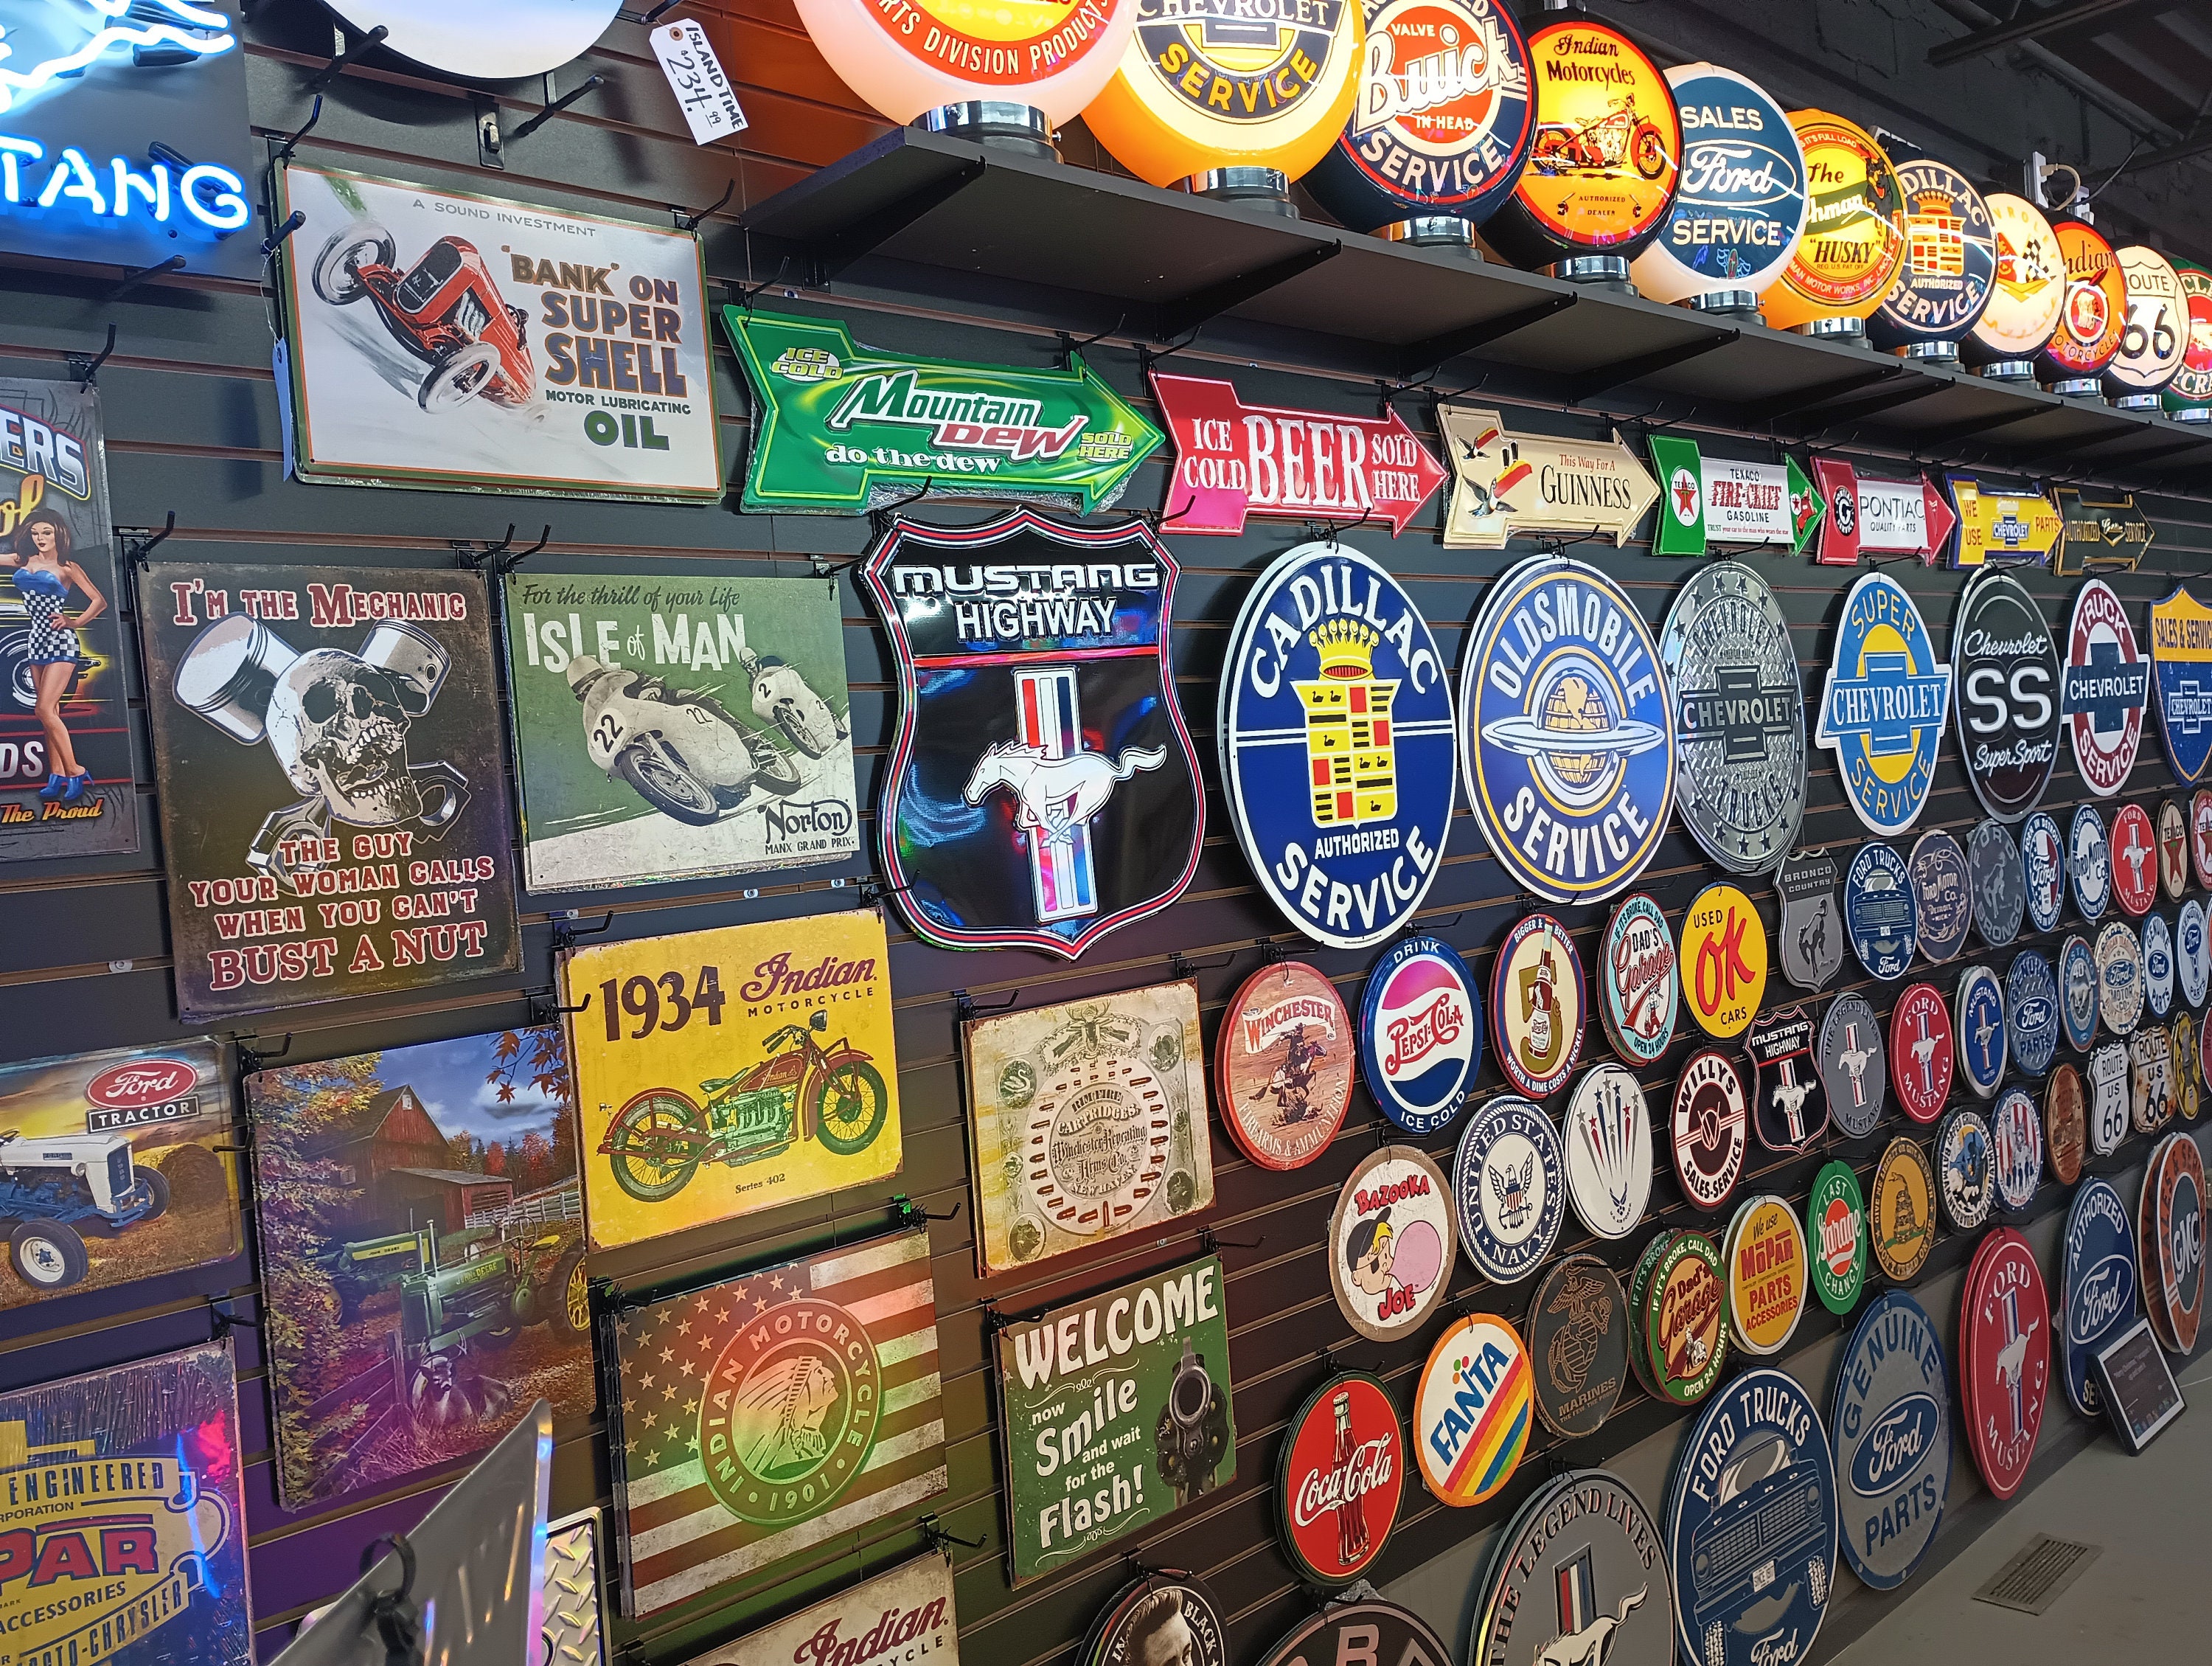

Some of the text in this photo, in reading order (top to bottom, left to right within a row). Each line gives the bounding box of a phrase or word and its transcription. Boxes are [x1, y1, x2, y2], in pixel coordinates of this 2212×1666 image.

[1391, 24, 1435, 37] VALVE
[1554, 34, 1619, 57] Indian
[685, 27, 743, 129] ISLAND TIME
[1159, 42, 1318, 113] SERVICE
[1352, 16, 1519, 137] Buick
[1547, 60, 1635, 91] Motorcycles
[1680, 106, 1763, 131] SALES
[1360, 131, 1503, 192] SERVICE
[1680, 147, 1773, 195] Ford
[1809, 162, 1843, 183] The
[1579, 195, 1626, 204] AUTHORIZED
[413, 199, 596, 236] A SOUND INVESTMENT
[1672, 219, 1781, 246] SERVICE
[1910, 278, 1963, 291] AUTHORIZED
[540, 291, 682, 344] SUPER
[1888, 282, 1979, 323] SERVICE
[544, 333, 687, 398] SHELL
[771, 361, 844, 379] COLD
[785, 347, 829, 362] ICE
[546, 389, 691, 415] MOTOR LUBRICATING
[833, 371, 1040, 426] Mountain
[584, 410, 669, 451] OIL
[1082, 432, 1132, 446] SOLD
[1192, 417, 1233, 452] ICE
[827, 443, 1001, 473] do the dew
[1079, 446, 1130, 459] HERE
[1242, 415, 1374, 510] BEER
[1371, 434, 1417, 467] SOLD
[1559, 454, 1615, 471] This Way For A
[1183, 456, 1246, 490] COLD
[1372, 470, 1420, 501] HERE
[1541, 464, 1631, 510] GUINNESS
[1730, 468, 1759, 482] TEXACO
[1709, 480, 1781, 510] FIRE-CHIEF
[1860, 496, 1924, 519] PONTIAC
[1965, 499, 1978, 517] WE
[1727, 510, 1769, 523] GASOLINE
[1993, 523, 2029, 538] CHEVROLET
[2035, 517, 2059, 532] PARTS
[1966, 528, 1982, 546] USE
[892, 563, 1158, 596] MUSTANG
[523, 585, 740, 614] For the thrill of your Life
[1851, 590, 1915, 642] SUPER
[957, 597, 1116, 642] HIGHWAY
[1250, 563, 1438, 698] CADILLAC
[2078, 594, 2125, 642] TRUCK
[523, 613, 745, 673] ISLE of MAN
[1489, 585, 1656, 707] OLDSMOBILE
[1964, 629, 2048, 656] Chevrolet
[758, 683, 771, 698] 2
[1833, 684, 1941, 726] CHEVROLET
[1966, 666, 2052, 734] SS
[2070, 676, 2143, 700] CHEVROLET
[1684, 697, 1790, 729] CHEVROLET
[2079, 722, 2137, 782] SERVICE
[1851, 751, 1930, 818] SERVICE
[43, 799, 103, 820] Proud
[758, 799, 852, 844] Norton
[2124, 811, 2141, 823] FORD
[279, 832, 413, 865] THE GUY
[765, 842, 791, 855] MANX
[797, 839, 827, 852] GRAND
[1315, 827, 1399, 859] AUTHORIZED
[1504, 785, 1652, 878] SERVICE
[189, 855, 494, 906] YOUR WOMAN CALLS
[1276, 825, 1433, 930] SERVICE
[1784, 866, 1832, 883] BRONCO
[1788, 878, 1830, 893] COUNTRY
[215, 889, 478, 940] WHEN YOU CAN'T
[1693, 909, 1723, 929] USED
[208, 920, 487, 990] BUST A NUT
[1394, 941, 1440, 963] DRINK
[1696, 906, 1756, 1017] OK
[1878, 956, 1900, 973] Ford
[599, 965, 726, 1041] 1934
[748, 988, 873, 1018] MOTORCYCLE
[1720, 1007, 1747, 1026] CARS
[1244, 999, 1335, 1052] WINCHESTER
[1752, 1022, 1808, 1046] MUSTANG
[1766, 1035, 1801, 1058] HIGHWAY
[2020, 1036, 2053, 1057] PARTS
[2139, 1038, 2167, 1059] ROUTE
[105, 1070, 179, 1097] Ford
[2102, 1055, 2124, 1077] ROUTE
[2148, 1066, 2163, 1081] US
[1679, 1060, 1736, 1114] WILLYS
[2107, 1084, 2120, 1097] US
[98, 1103, 189, 1126] TRACTOR
[1401, 1090, 1465, 1128] ICE COLD
[2103, 1100, 2123, 1142] 66
[735, 1173, 785, 1194] Series 402
[1468, 1115, 1557, 1235] UNITED STATES
[1684, 1137, 1742, 1199] SALES-SERVICE
[1354, 1175, 1430, 1215] BAZOOKA
[1823, 1181, 1846, 1206] LAST
[1492, 1232, 1543, 1264] NAVY
[2073, 1193, 2124, 1271] AUTHORIZED
[1750, 1274, 1792, 1312] PARTS
[1825, 1260, 1859, 1295] CHANCE
[1745, 1296, 1798, 1332] ACCESSORIES
[2080, 1266, 2121, 1336] Ford
[1015, 1266, 1218, 1390] WELCOME
[1684, 1322, 1728, 1397] OPEN 24 HOURS
[1843, 1313, 1942, 1438] GENUINE
[709, 1311, 872, 1495] INDIAN MOTORCYCLE
[1032, 1401, 1065, 1426] now
[1430, 1342, 1509, 1466] FANTA
[1558, 1377, 1616, 1417] MARINES
[1035, 1378, 1138, 1477] Smile
[1082, 1425, 1141, 1464] and wait
[1692, 1386, 1810, 1503] FORD TRUCKS
[1868, 1409, 1923, 1482] Ford
[9, 1462, 164, 1506] ENGINEERED
[770, 1474, 830, 1512] 1901
[1065, 1461, 1115, 1492] for the
[1295, 1432, 1394, 1527] Coca-Cola
[1039, 1464, 1144, 1548] Flash!
[1865, 1474, 1936, 1556] PARTS
